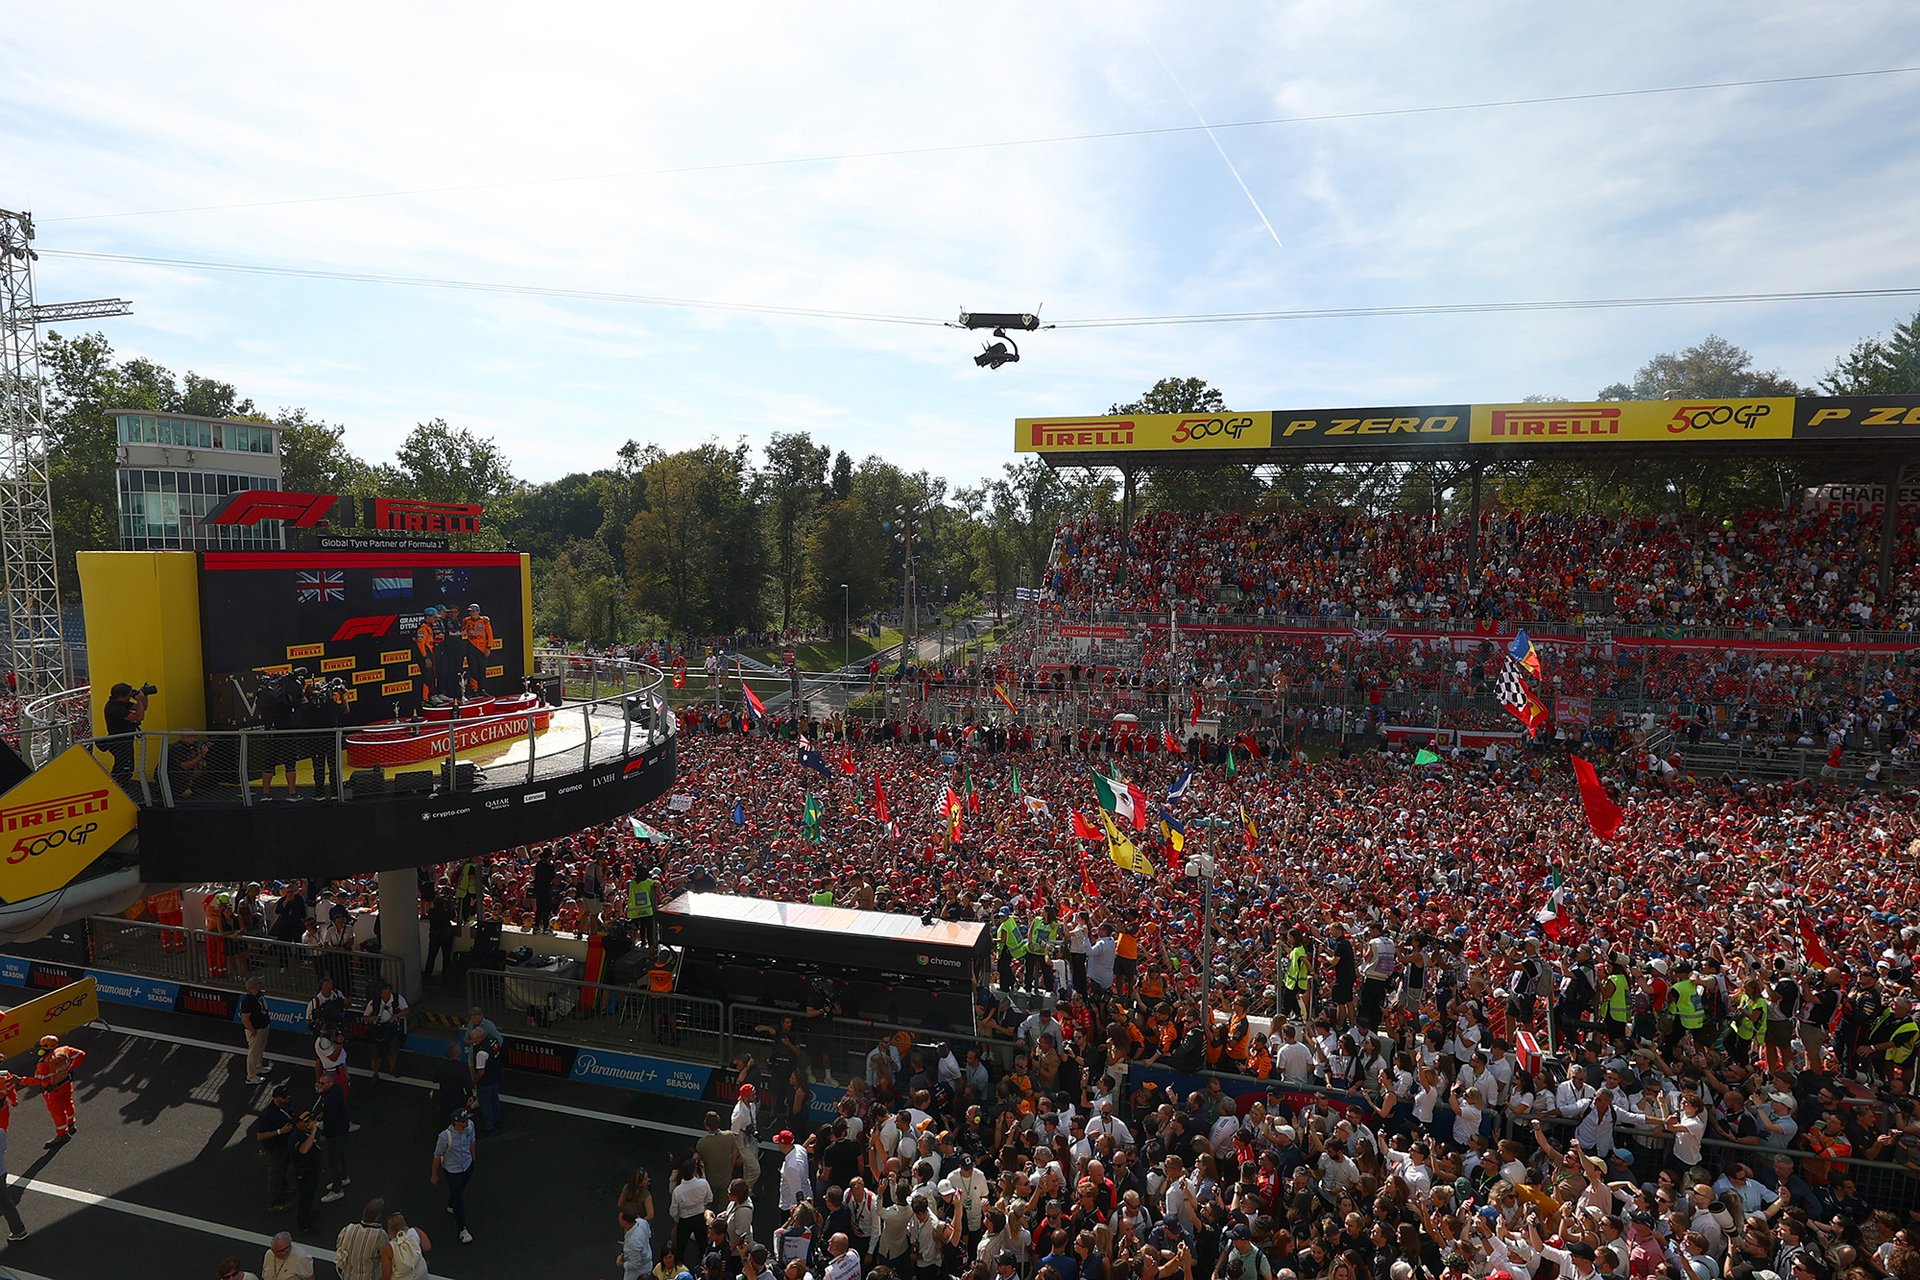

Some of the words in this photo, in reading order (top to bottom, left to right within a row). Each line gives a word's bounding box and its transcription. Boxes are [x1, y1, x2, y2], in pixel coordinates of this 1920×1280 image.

[1491, 408, 1622, 436] PIRELLI
[1807, 408, 1852, 426] P
[1282, 419, 1317, 437] P
[1324, 415, 1459, 436] ZERO
[1032, 421, 1136, 447] PIRELLI
[1829, 487, 1920, 502] CHARES
[375, 498, 482, 533] PIRELLI
[321, 538, 349, 548] Global
[350, 539, 368, 549] Tyre
[369, 540, 397, 548] Partner
[398, 540, 407, 548] of
[408, 540, 437, 549] Formula
[478, 707, 484, 716] 1
[470, 731, 480, 745] &
[592, 772, 616, 787] LVMH
[557, 784, 583, 795] aramco
[485, 797, 510, 808] QATAR
[0, 789, 109, 833] PIRELLI
[432, 807, 471, 819] crypto.com
[930, 956, 961, 968] chrome
[575, 1054, 658, 1083] Paramount+
[672, 1070, 693, 1081] NEW
[665, 1078, 701, 1091] SEASON
